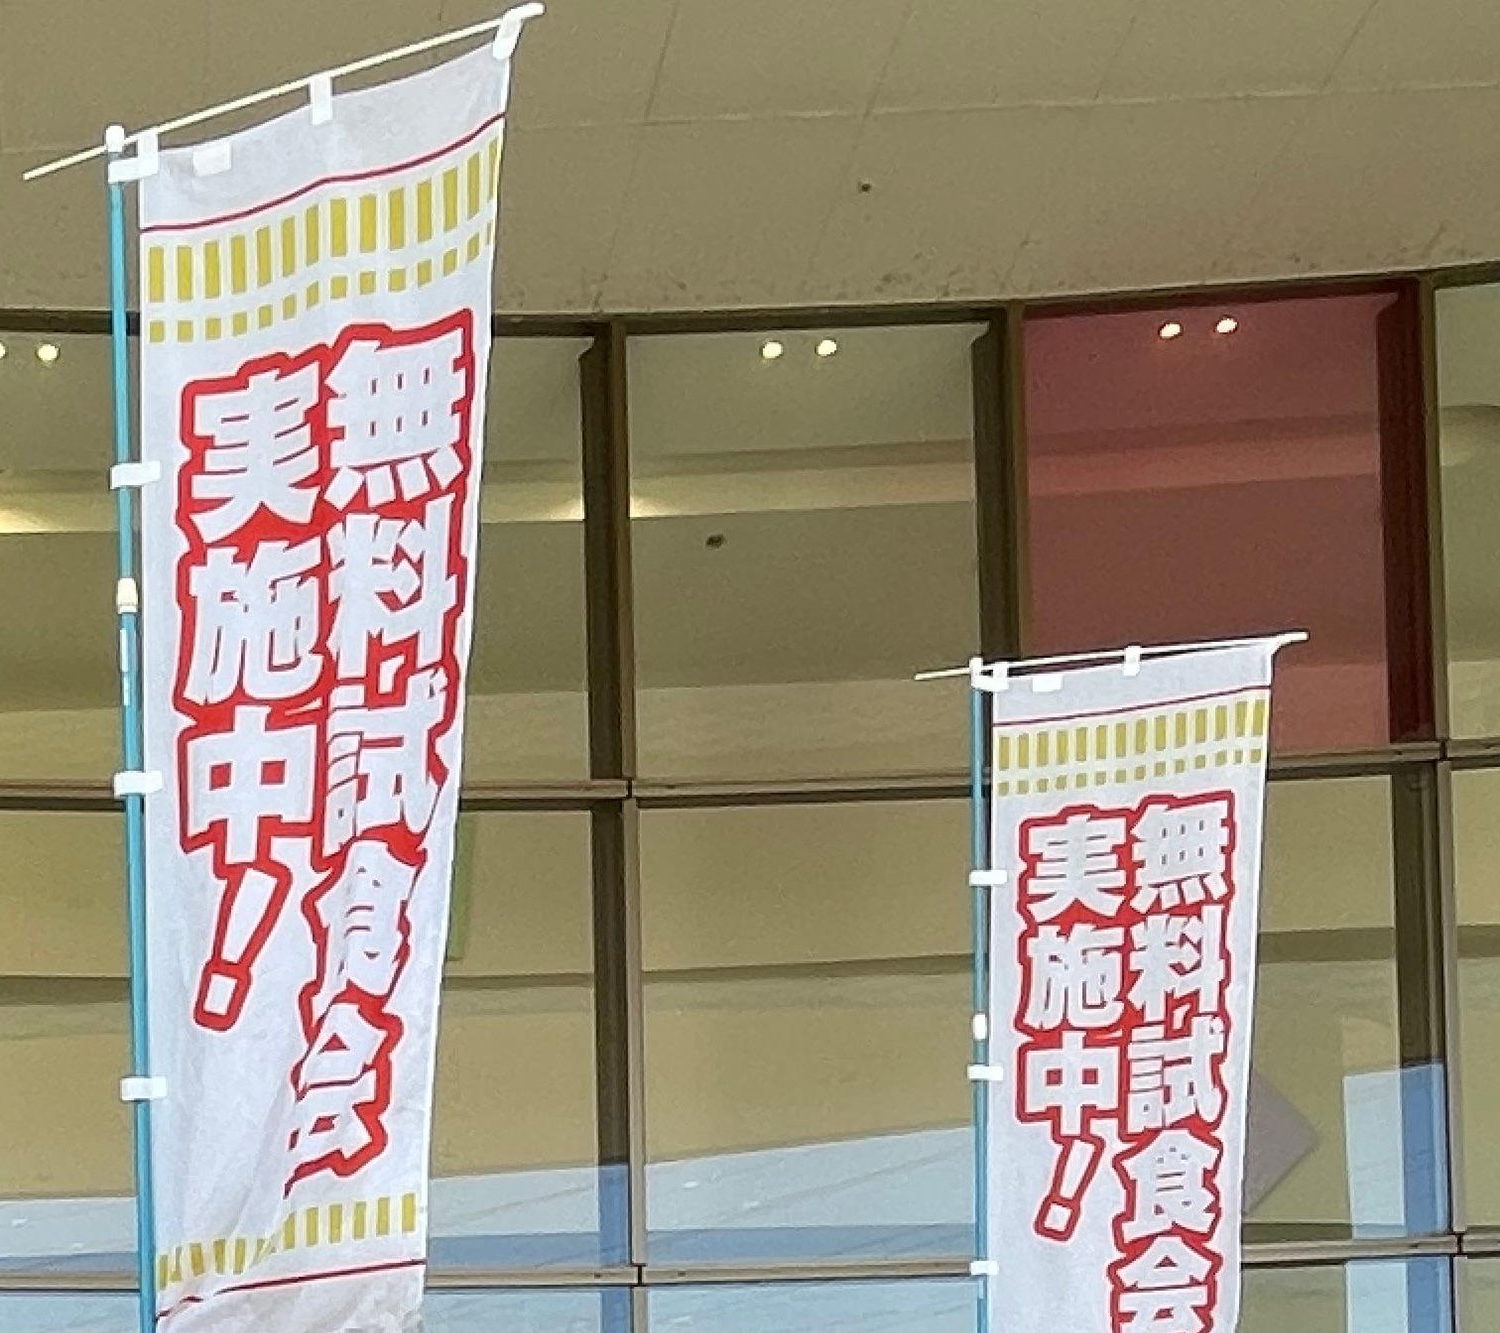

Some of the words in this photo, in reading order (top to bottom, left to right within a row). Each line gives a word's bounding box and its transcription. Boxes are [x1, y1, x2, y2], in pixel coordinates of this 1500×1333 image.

[285, 308, 474, 1196] 無料試食会
[1014, 803, 1132, 1243] 実施中!
